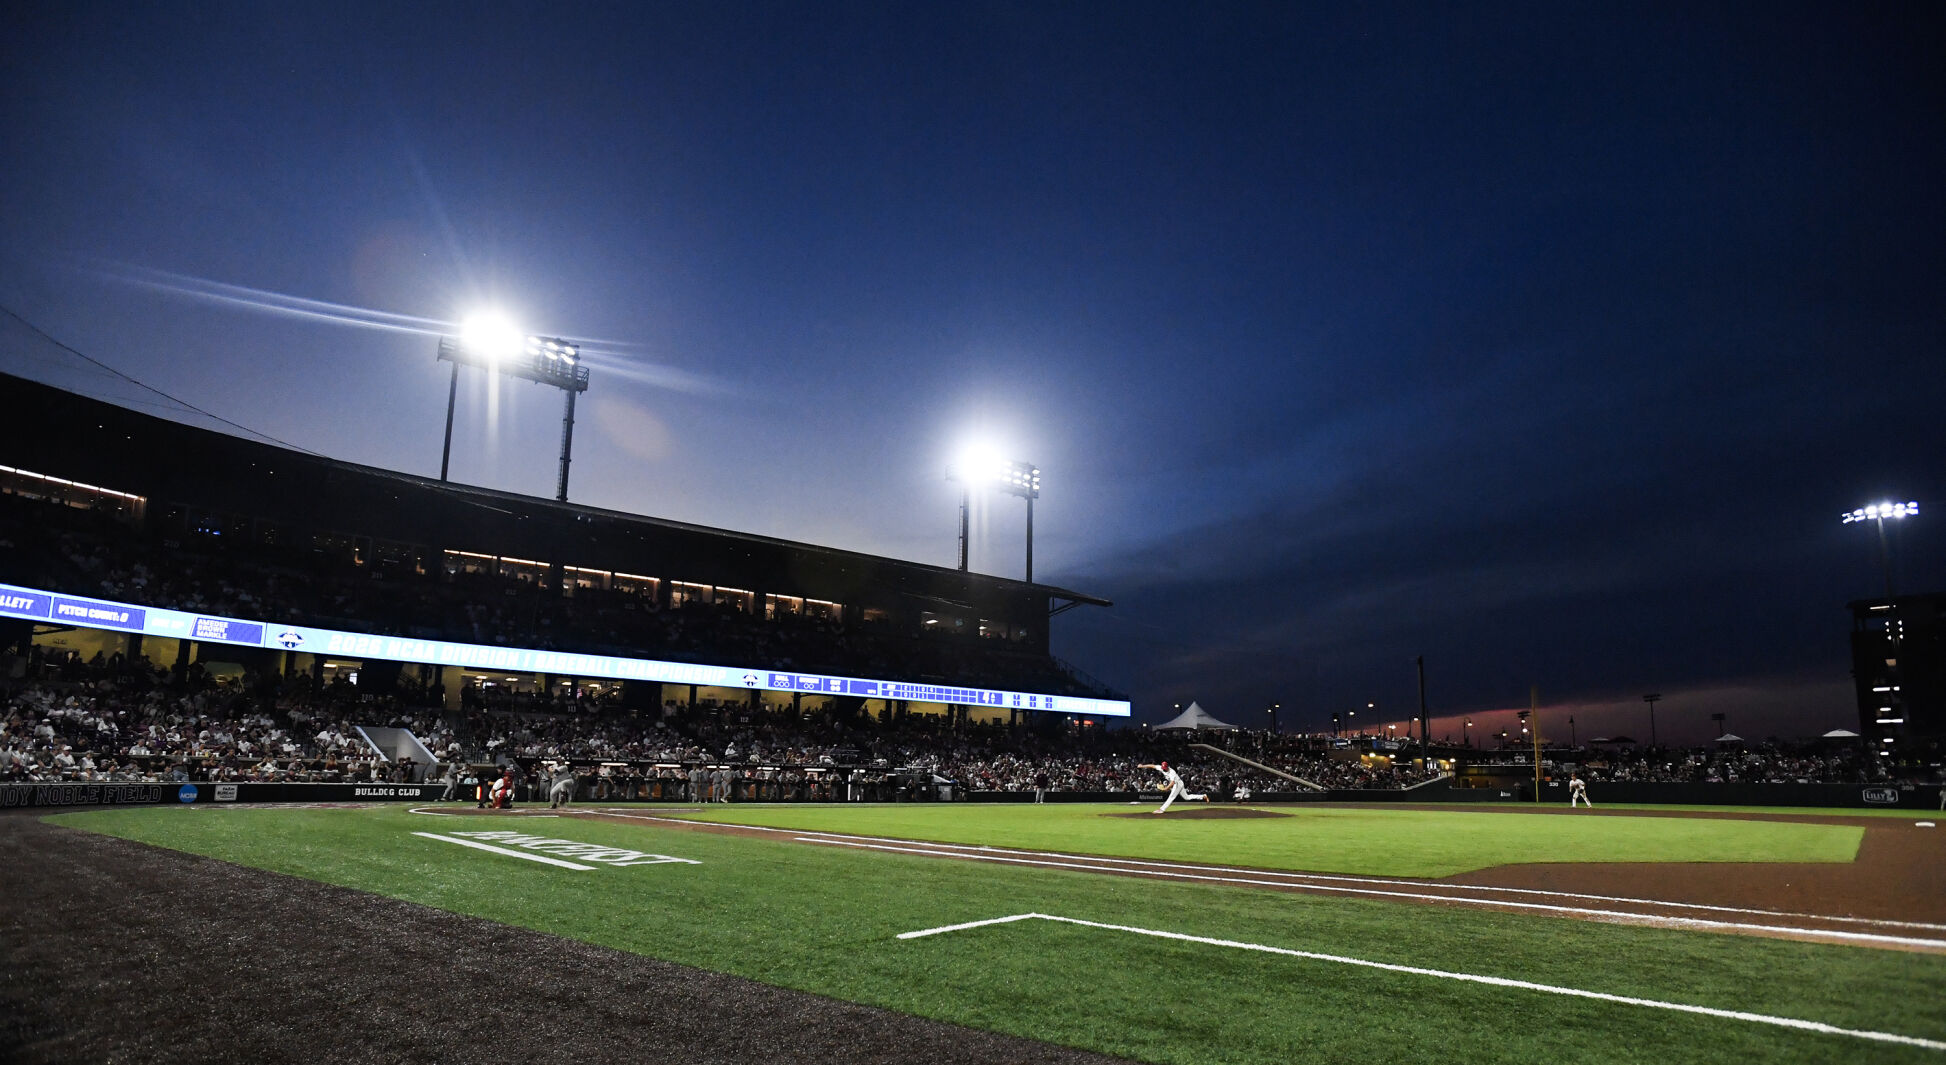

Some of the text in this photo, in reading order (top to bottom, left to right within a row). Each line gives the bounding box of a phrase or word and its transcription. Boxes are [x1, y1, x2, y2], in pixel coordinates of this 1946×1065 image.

[58, 604, 88, 617] PITCH
[196, 630, 228, 640] MARKLE
[386, 640, 436, 660] NCAA
[440, 645, 520, 667] DIVISION
[522, 653, 532, 668] I
[534, 653, 612, 675] BASEBALL
[616, 660, 728, 683] CHAMPIONSHIP
[35, 785, 101, 806] NOBLE
[102, 785, 161, 804] FIELD
[398, 788, 421, 796] CLUB
